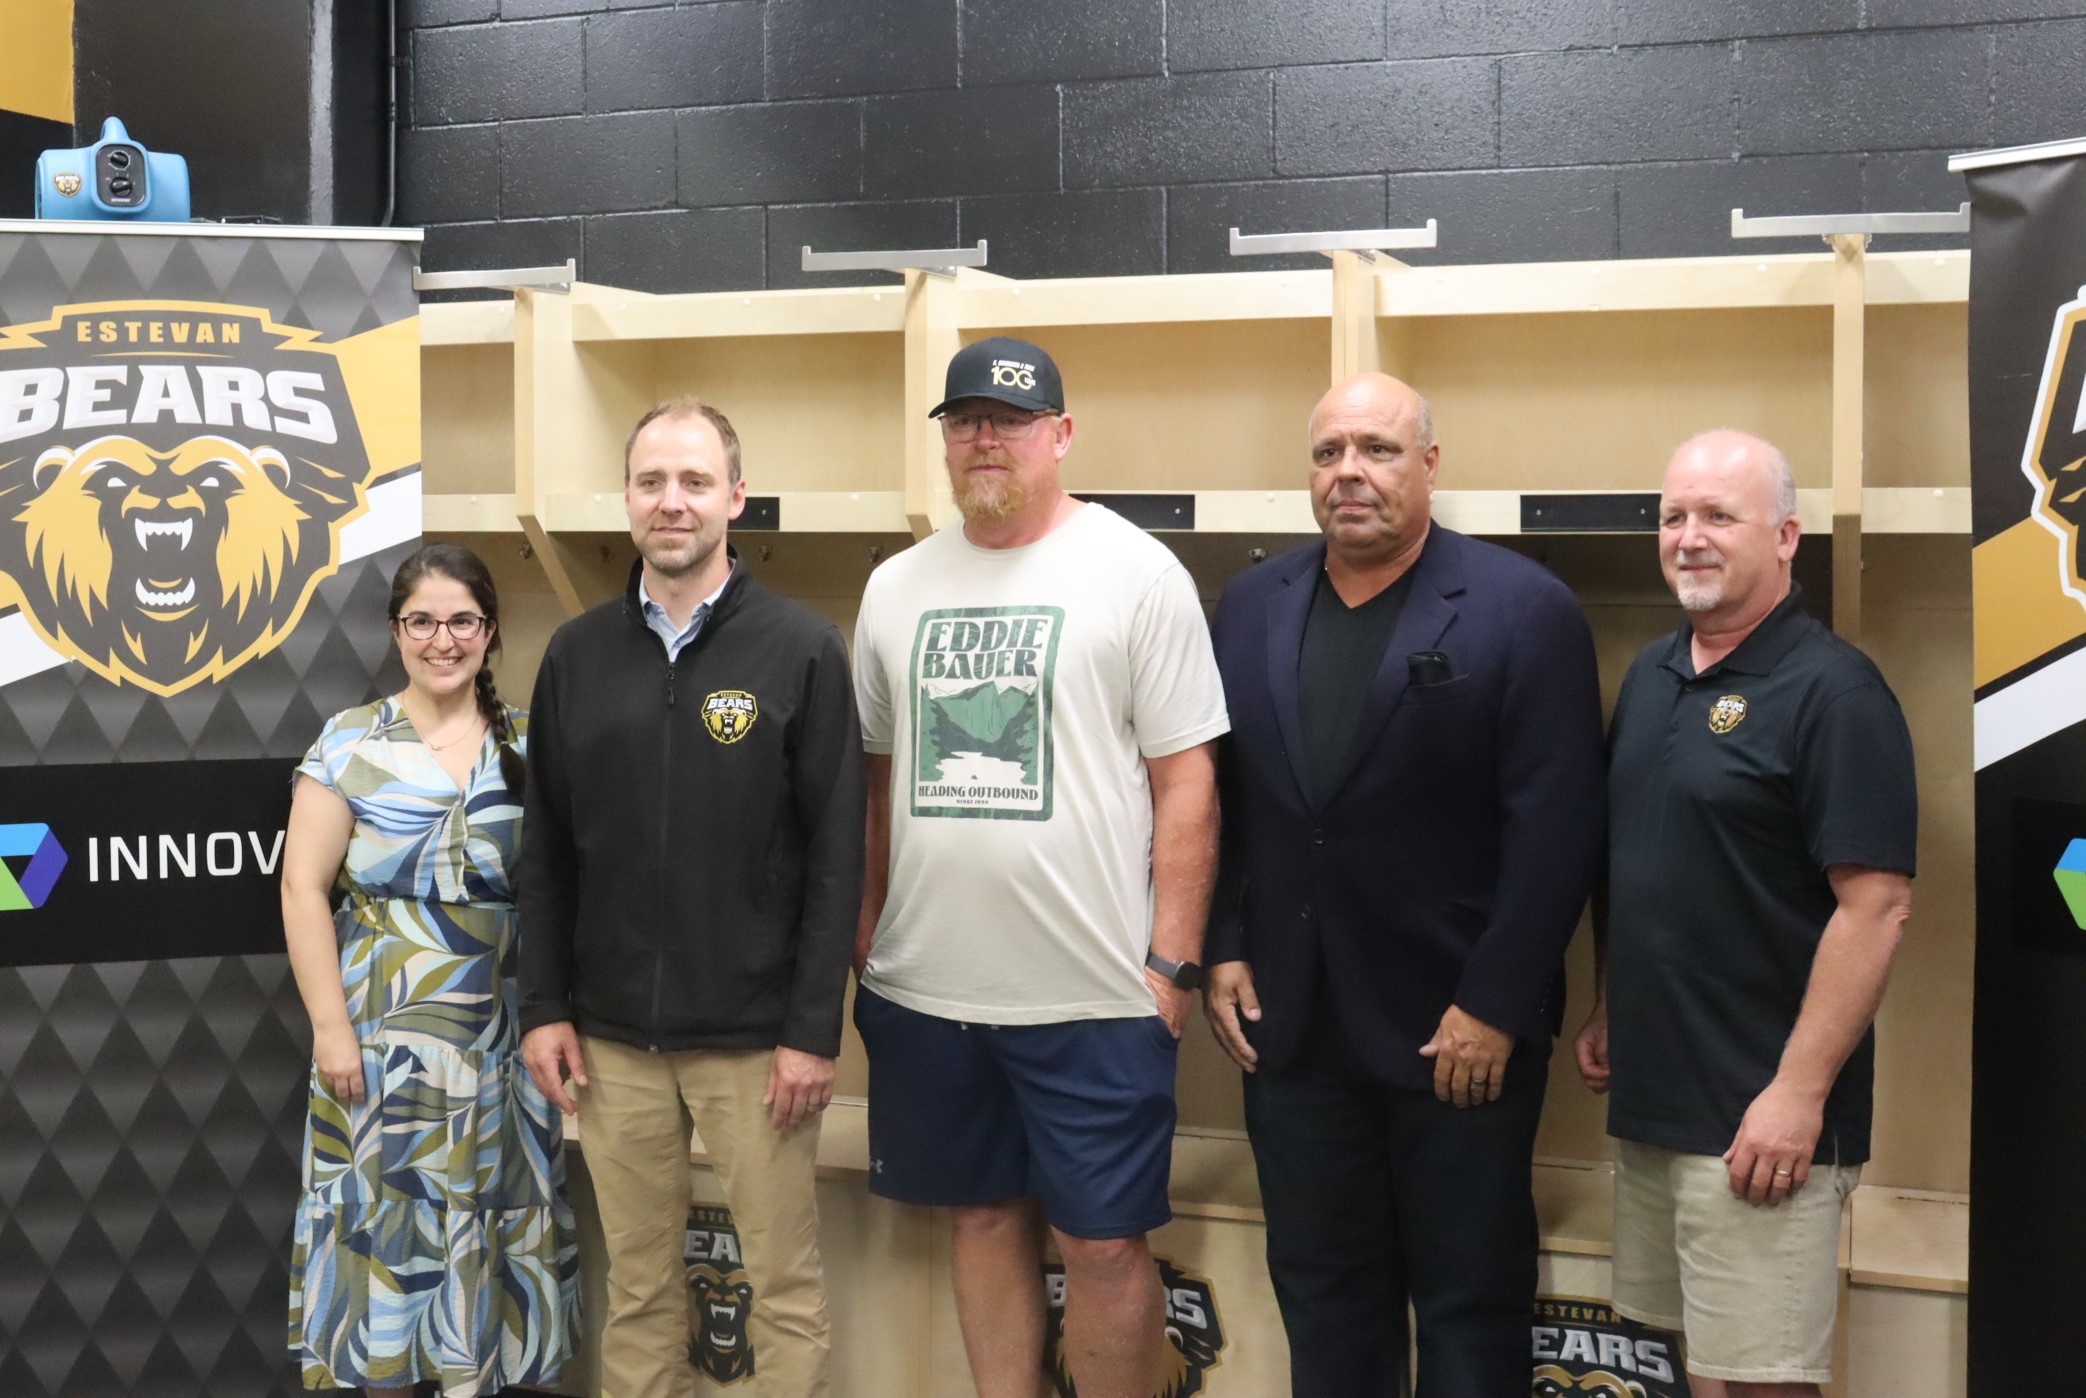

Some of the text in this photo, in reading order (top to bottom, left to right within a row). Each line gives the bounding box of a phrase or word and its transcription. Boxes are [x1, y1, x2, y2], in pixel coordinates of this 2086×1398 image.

[76, 320, 241, 344] ESTEVAN
[0, 364, 338, 445] BEARS
[926, 618, 1048, 652] EDDIE
[922, 649, 1038, 680] BAUER
[706, 698, 752, 711] BEARS
[918, 785, 1039, 801] HEADING OUTBOUND
[1532, 1303, 1623, 1324] ESTEVAN
